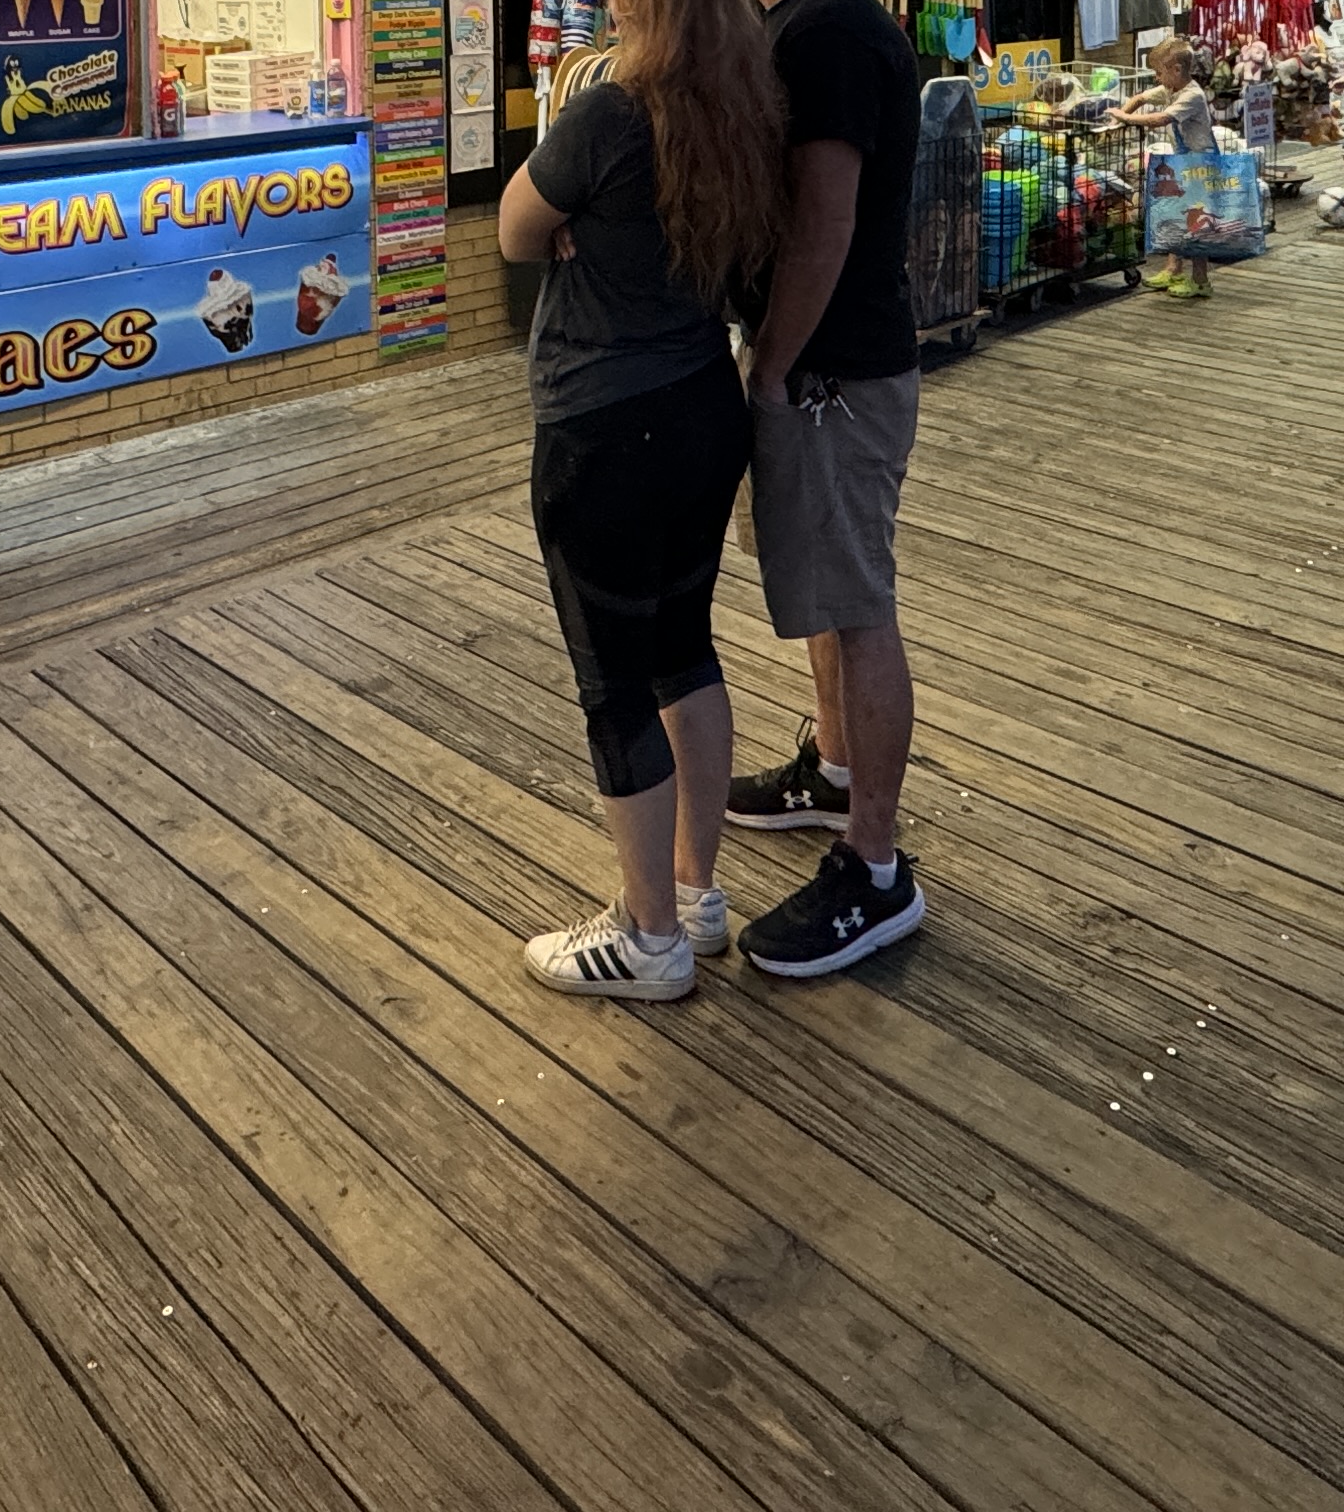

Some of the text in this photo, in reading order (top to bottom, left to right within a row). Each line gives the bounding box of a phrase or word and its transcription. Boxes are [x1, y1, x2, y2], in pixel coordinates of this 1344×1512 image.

[48, 50, 117, 84] Chocolate
[974, 49, 1051, 88] 5 & 10
[53, 90, 112, 116] BANANAS
[164, 108, 176, 121] G
[141, 164, 353, 238] FLAVORS
